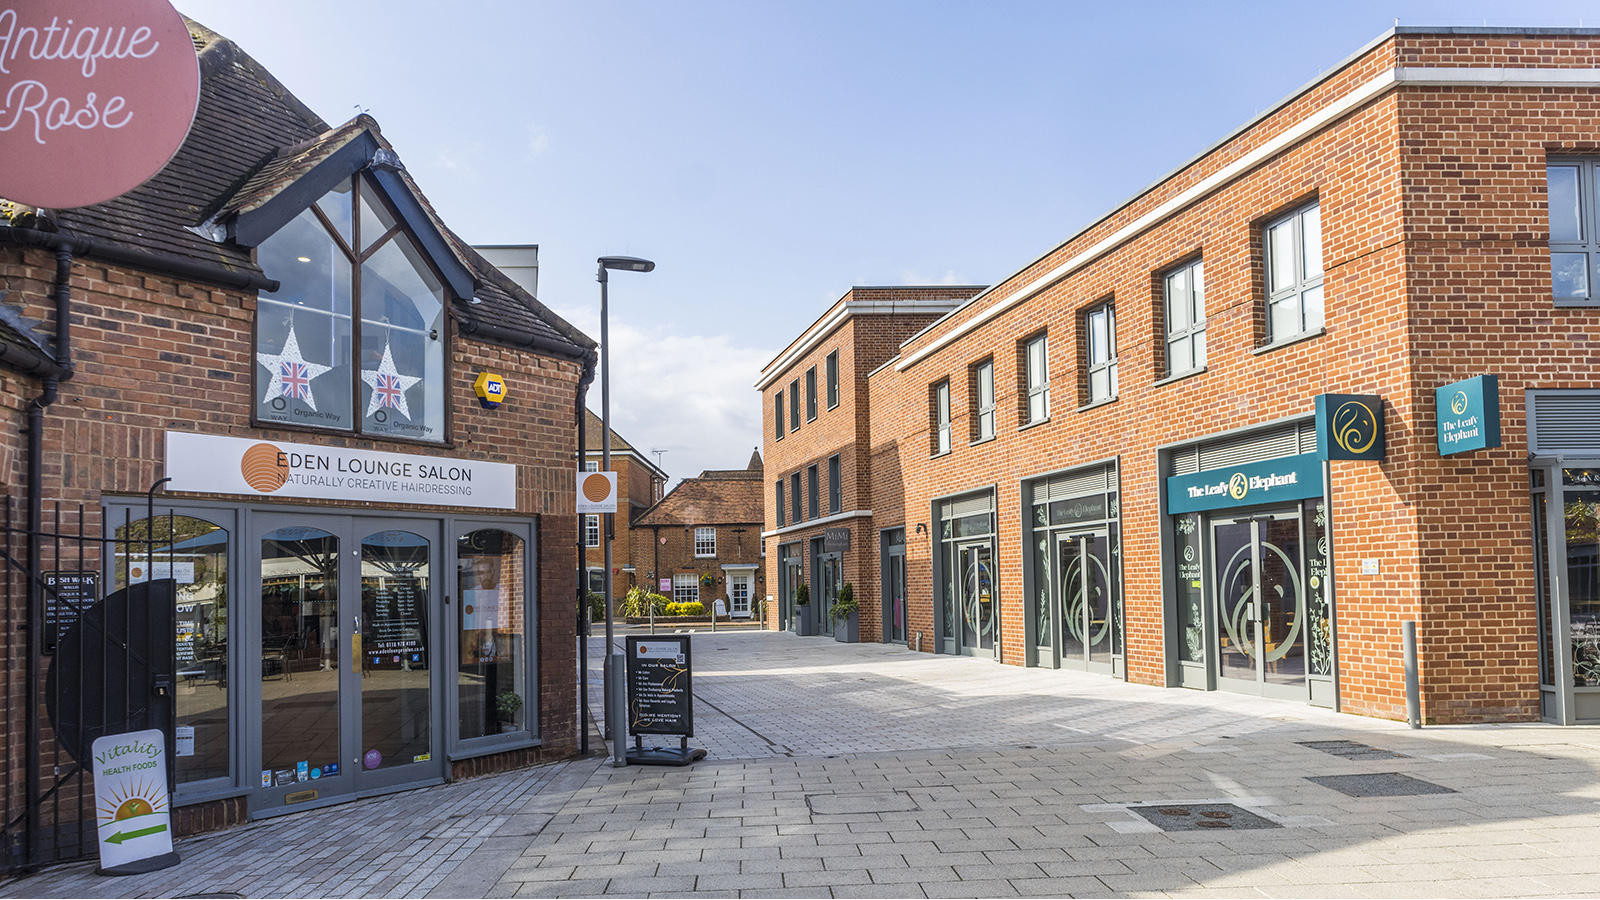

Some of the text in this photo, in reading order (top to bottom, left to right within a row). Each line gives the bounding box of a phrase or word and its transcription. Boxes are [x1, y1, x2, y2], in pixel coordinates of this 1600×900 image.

[0, 9, 159, 77] Antique
[0, 80, 133, 144] Rose
[488, 383, 501, 393] ADT
[294, 408, 341, 422] Organic Way
[393, 421, 433, 433] Organic Way
[1442, 415, 1478, 431] The Leafy
[1443, 427, 1479, 443] Elephant
[277, 451, 471, 482] EDEN LOUNGE SALON
[277, 472, 472, 496] NATURALLY CREATIVE HAIRDRESSING
[1187, 471, 1298, 498] The Leafy Elephant
[1082, 504, 1102, 514] Elephant
[1188, 563, 1200, 571] Leafy
[1310, 567, 1327, 578] Elep
[48, 577, 70, 585] BSH
[1179, 571, 1200, 580] Elephant
[176, 604, 194, 612] OW
[95, 740, 162, 765] Vitality
[103, 760, 157, 776] HEALTH FOODS
